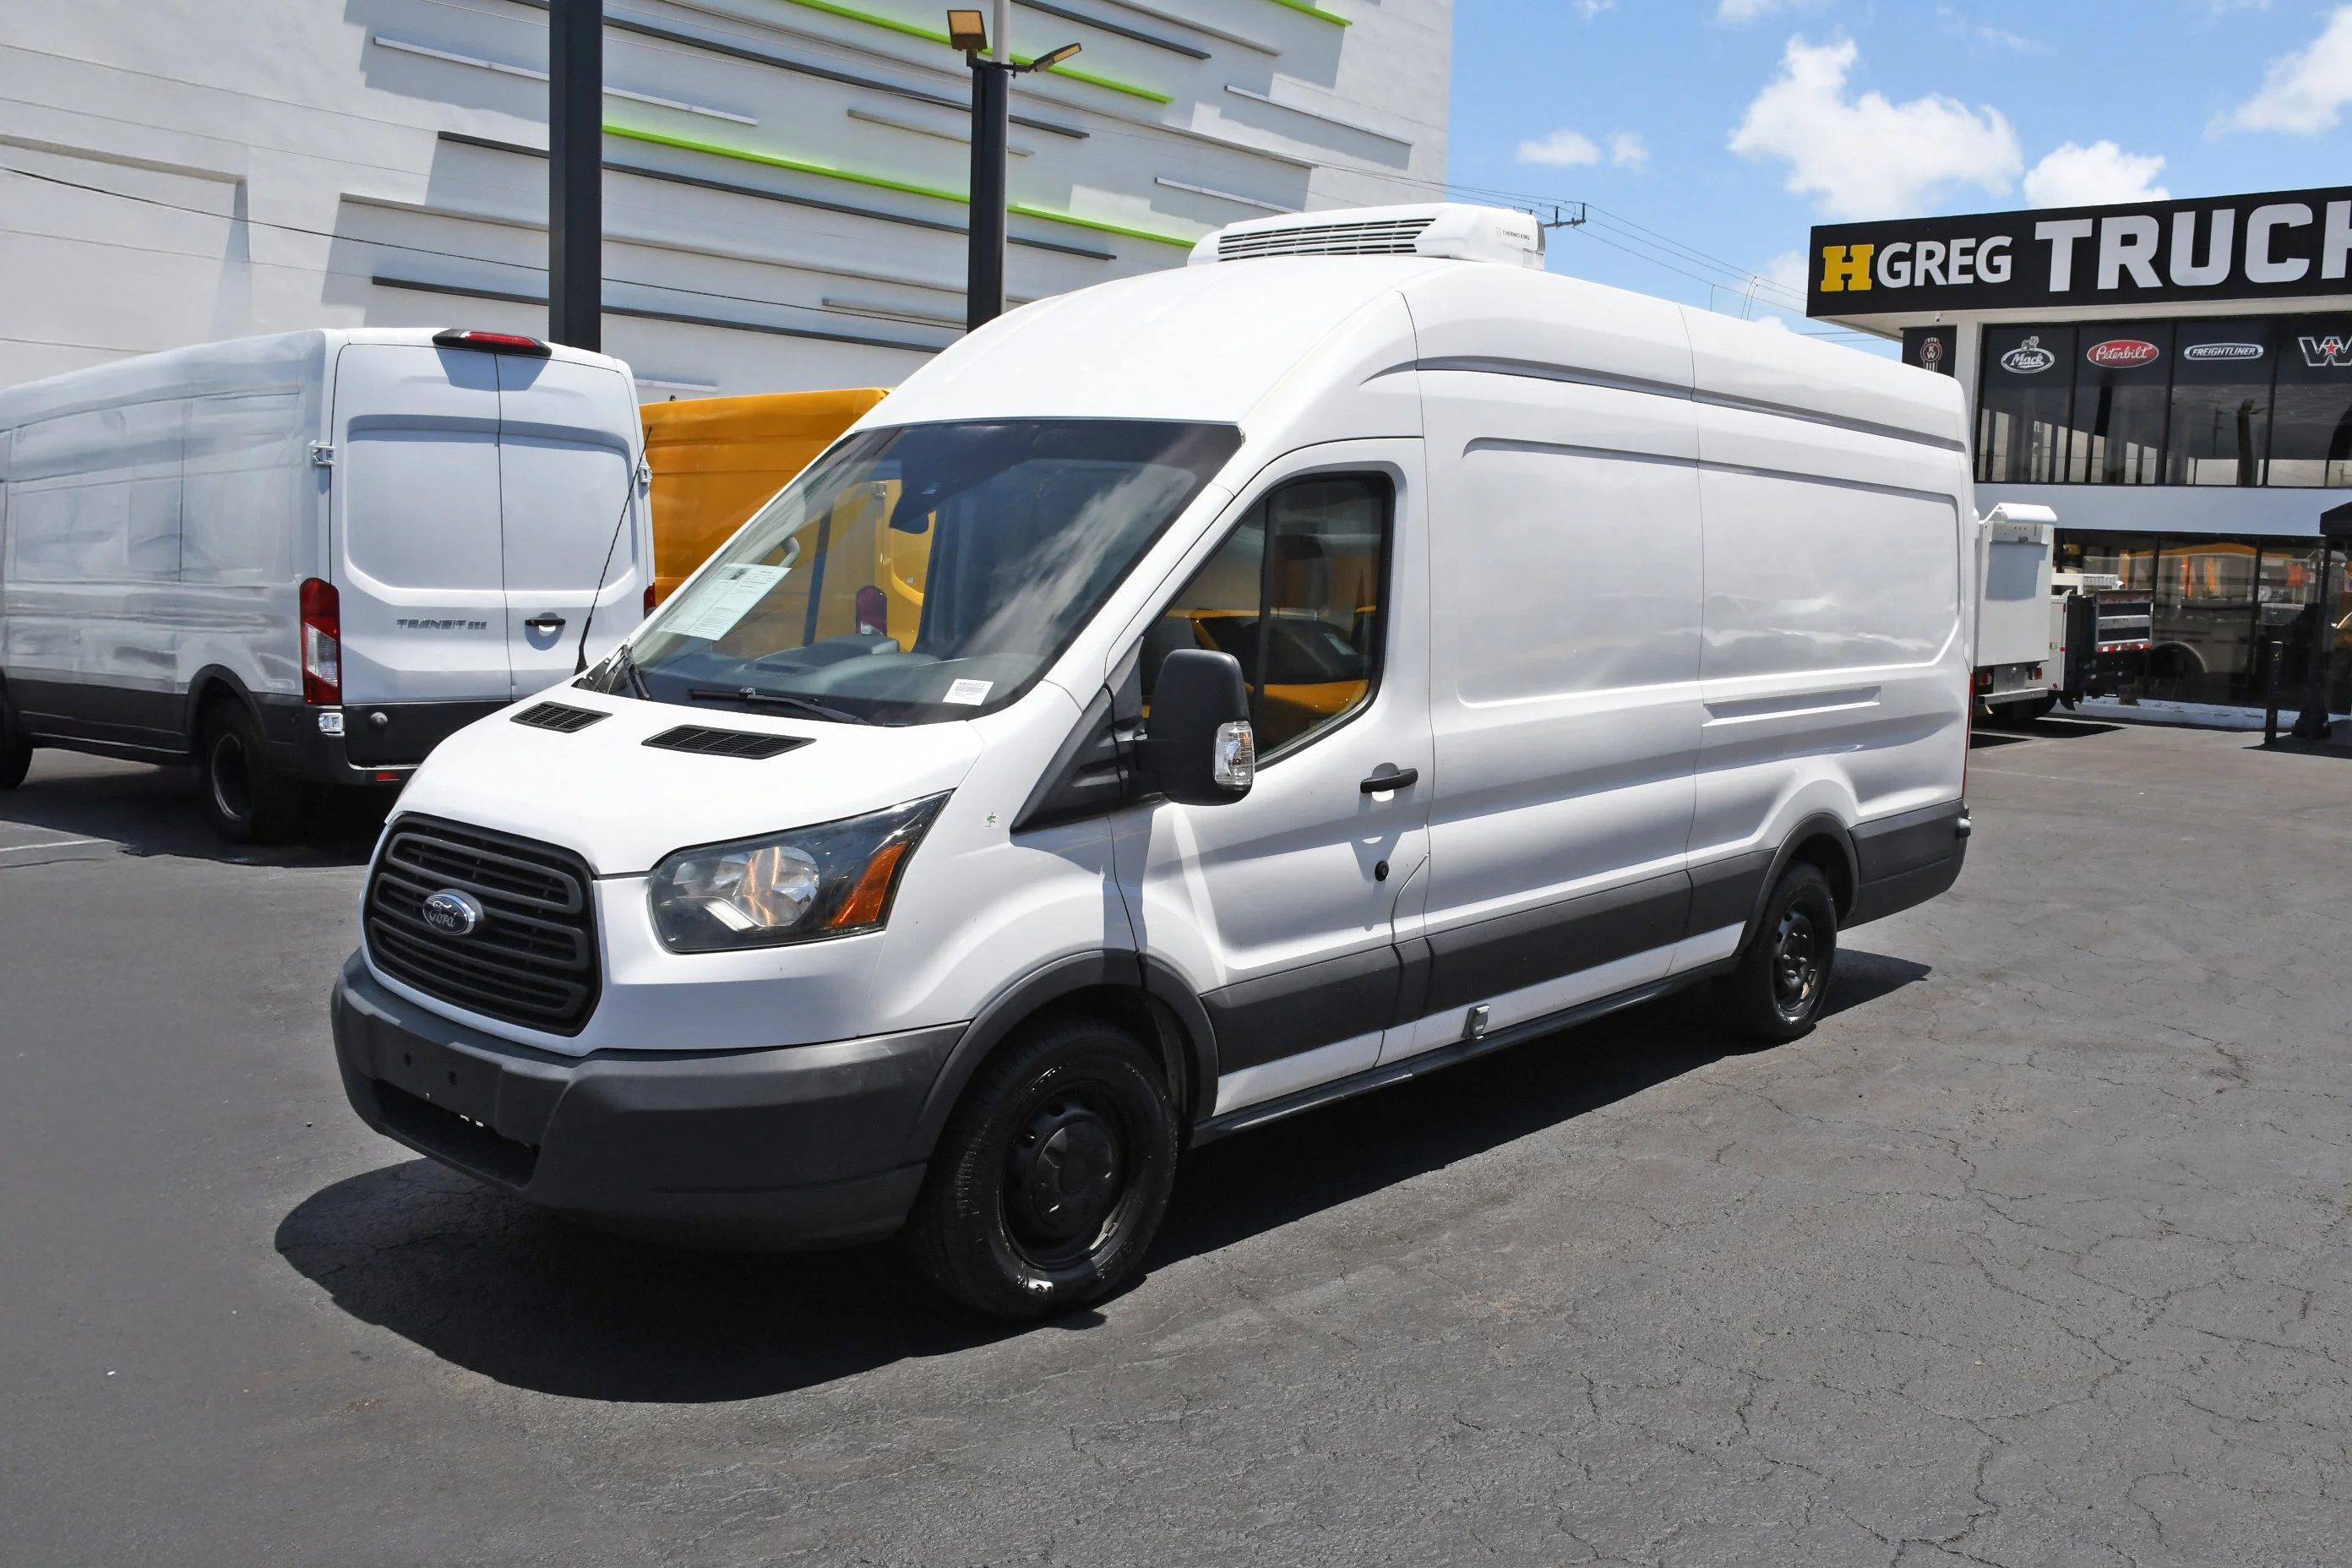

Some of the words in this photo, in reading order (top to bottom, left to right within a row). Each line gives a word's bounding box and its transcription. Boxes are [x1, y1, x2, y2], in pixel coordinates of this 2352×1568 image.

[1502, 229, 1520, 238] THERMO
[2095, 344, 2153, 362] Peterbilt
[2191, 346, 2256, 357] FREIGHTLINER
[2010, 352, 2044, 368] Mack
[396, 618, 466, 629] TRANSIT
[429, 900, 457, 928] Ford
